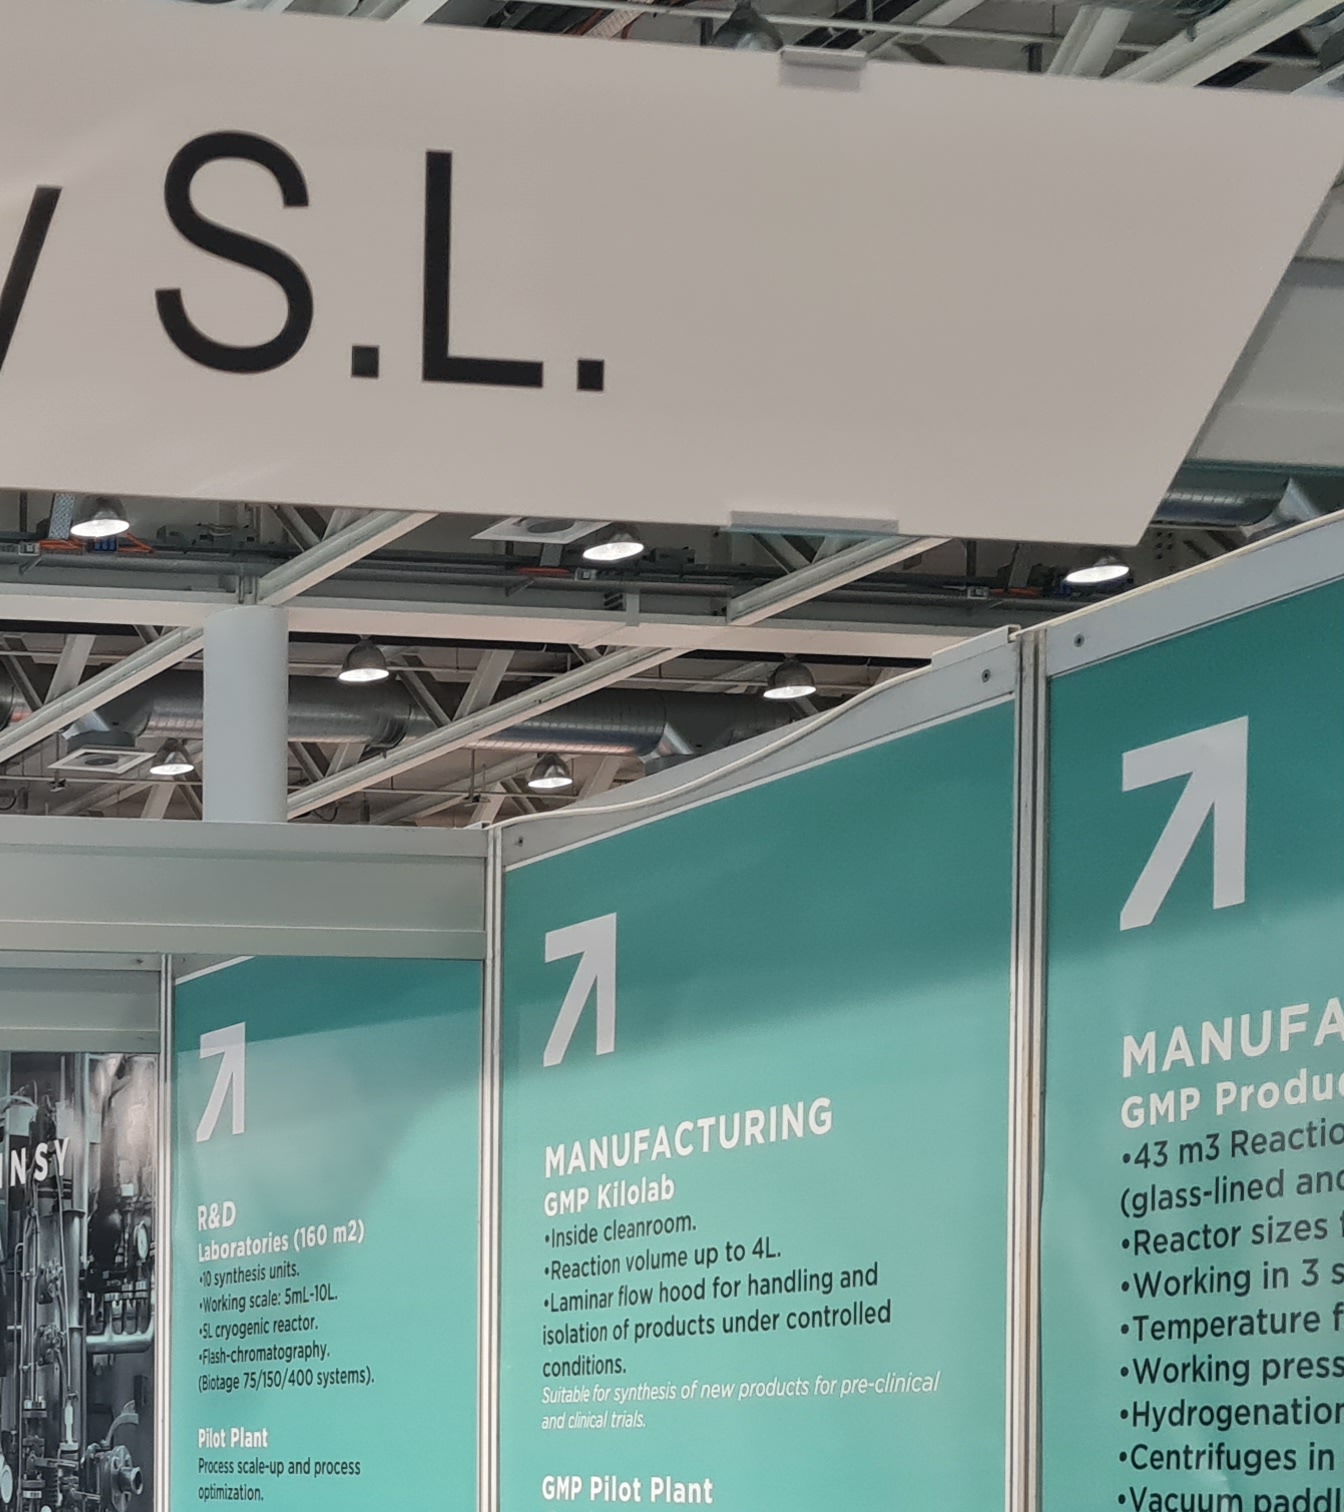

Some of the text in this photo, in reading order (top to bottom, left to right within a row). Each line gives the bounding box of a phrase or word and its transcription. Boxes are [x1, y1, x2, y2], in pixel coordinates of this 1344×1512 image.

[155, 129, 605, 391] S.L.
[1121, 1086, 1200, 1128] GMP
[544, 1096, 833, 1178] MANUFACTURING
[1179, 1132, 1219, 1165] m3
[544, 1174, 674, 1216] GMP Kilolab
[1120, 1168, 1284, 1218] (glass-lined
[197, 1200, 237, 1231] R&D
[603, 1214, 696, 1241] cleanroom.
[1251, 1215, 1327, 1245] sizes
[198, 1218, 364, 1262] Laboratories (160 m2)
[625, 1248, 688, 1272] volume
[694, 1246, 718, 1269] up
[725, 1241, 745, 1262] to
[751, 1236, 781, 1259] 4L.
[213, 1263, 266, 1288] synthesis
[269, 1260, 299, 1279] units.
[618, 1284, 653, 1306] flow
[659, 1277, 705, 1303] hood
[712, 1276, 741, 1299] for
[748, 1268, 832, 1296] handling
[840, 1260, 878, 1288] and
[1263, 1260, 1288, 1289] in
[1301, 1258, 1319, 1286] 3
[249, 1289, 281, 1308] scale:
[284, 1282, 337, 1305] 5mL-10L.
[542, 1298, 890, 1345] isolation of products under controlled
[542, 1354, 626, 1377] conditions.
[198, 1426, 268, 1448] Pilot Plant
[198, 1456, 360, 1478] Process scale-up and process
[1308, 1441, 1334, 1470] in
[198, 1482, 264, 1502] optimization.
[542, 1475, 712, 1504] GMP Pilot Plant
